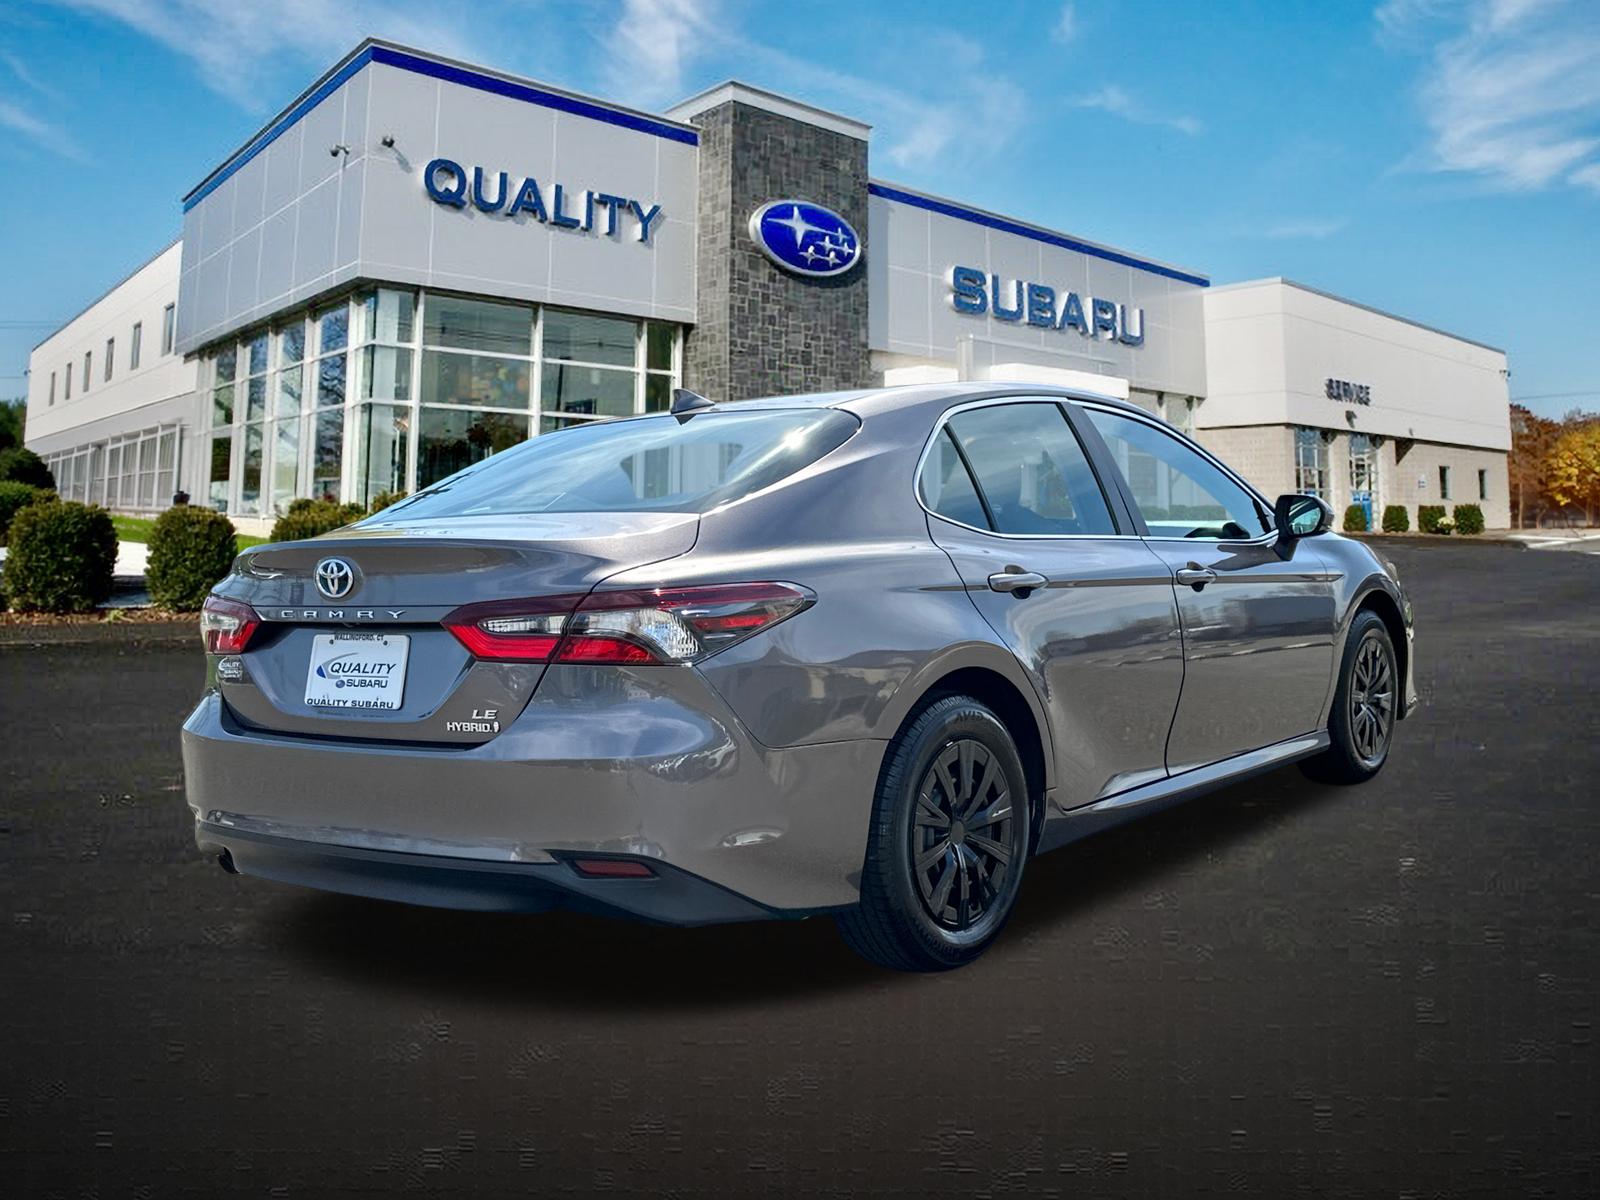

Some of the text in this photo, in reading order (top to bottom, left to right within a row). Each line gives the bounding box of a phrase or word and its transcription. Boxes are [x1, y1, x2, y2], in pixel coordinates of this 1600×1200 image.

[424, 158, 662, 243] QUALITY
[947, 265, 1145, 347] SUBARU
[1325, 378, 1371, 407] SERVICE
[280, 609, 406, 620] CAMRY
[377, 633, 384, 641] CT
[330, 662, 397, 675] QUALITY
[346, 678, 389, 689] SUBARU
[306, 697, 394, 709] QUALITY SUBARU
[472, 709, 498, 720] LE
[446, 721, 491, 733] HYBRID
